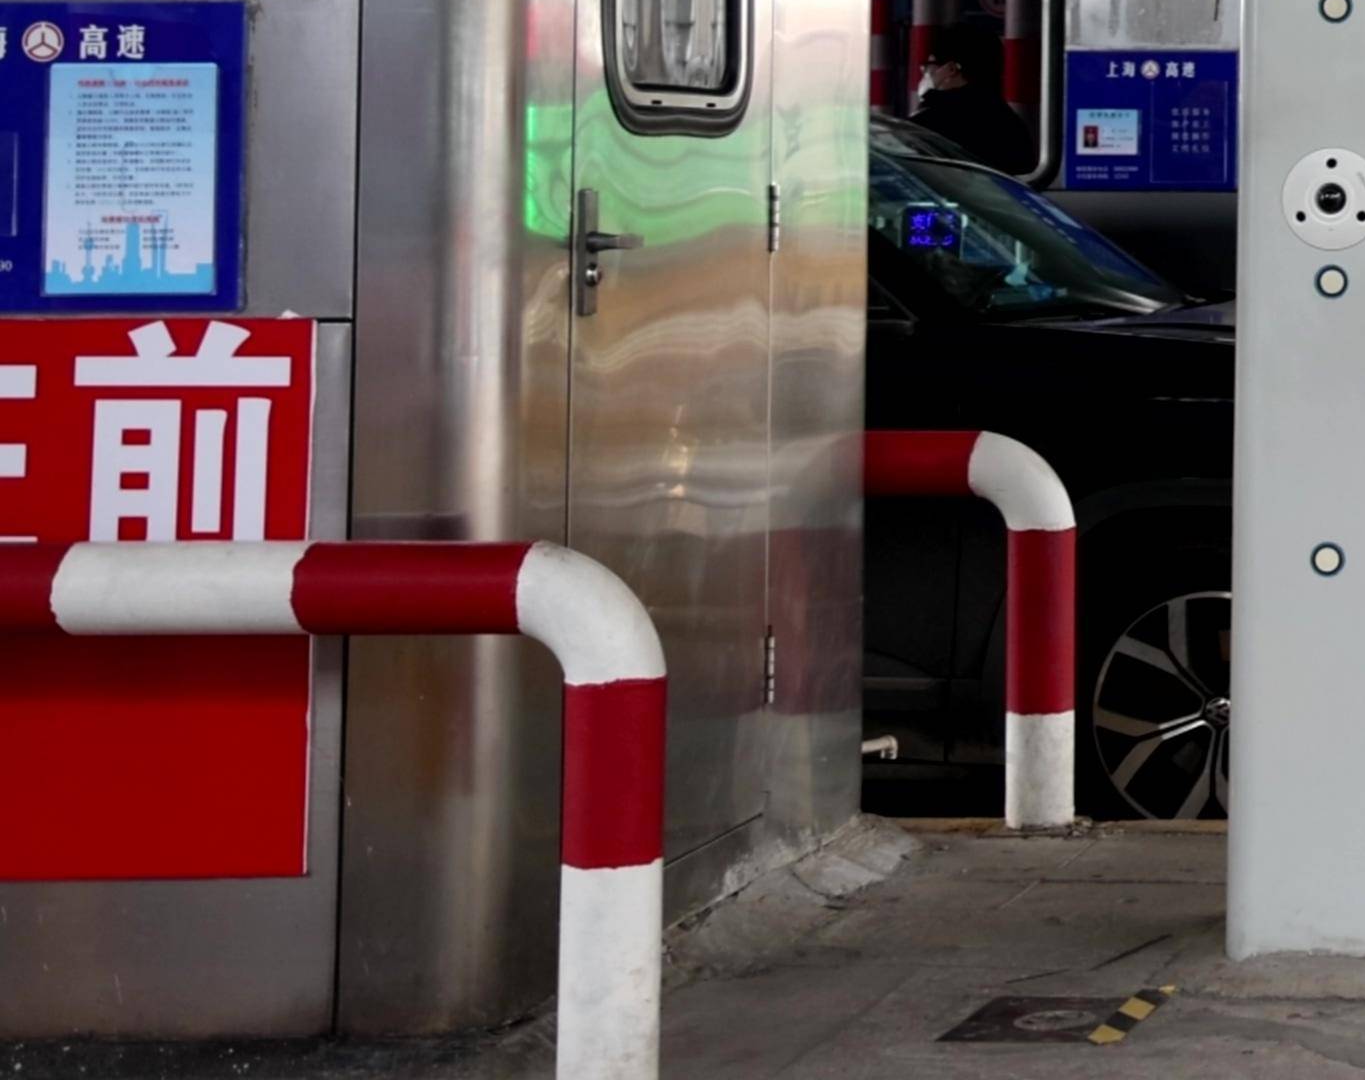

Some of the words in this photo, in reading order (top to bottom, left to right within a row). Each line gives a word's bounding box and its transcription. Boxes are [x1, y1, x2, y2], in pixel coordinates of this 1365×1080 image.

[79, 23, 146, 60] 高速
[1105, 61, 1136, 78] 上海
[1165, 61, 1196, 78] 高速
